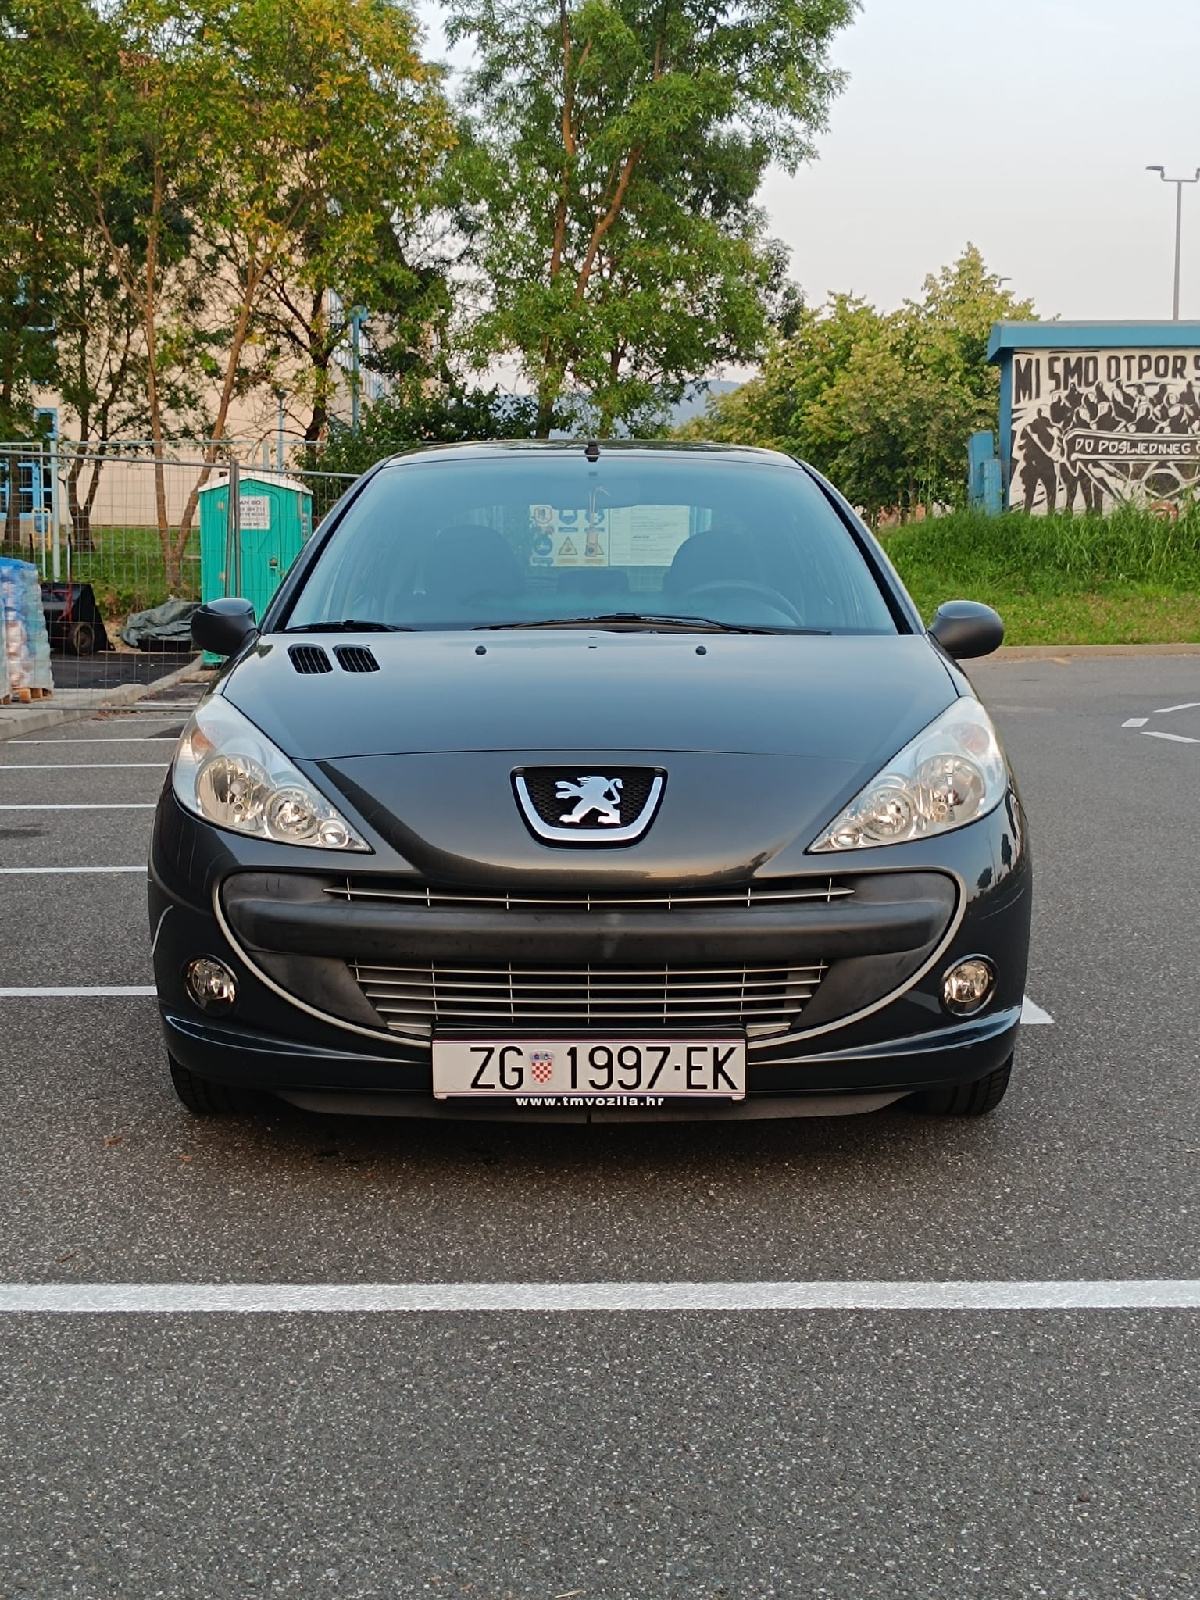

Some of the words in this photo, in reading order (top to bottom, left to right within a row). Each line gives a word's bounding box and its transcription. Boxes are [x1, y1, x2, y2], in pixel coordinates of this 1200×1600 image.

[1014, 358, 1040, 405] MI
[1048, 356, 1098, 393] SMO
[1106, 354, 1187, 382] OTPOR
[1075, 438, 1094, 453] DO
[1098, 440, 1191, 454] POSLJEDNJEG
[470, 1046, 524, 1090] ZG
[515, 1097, 665, 1106] www.tmvozila.hr
